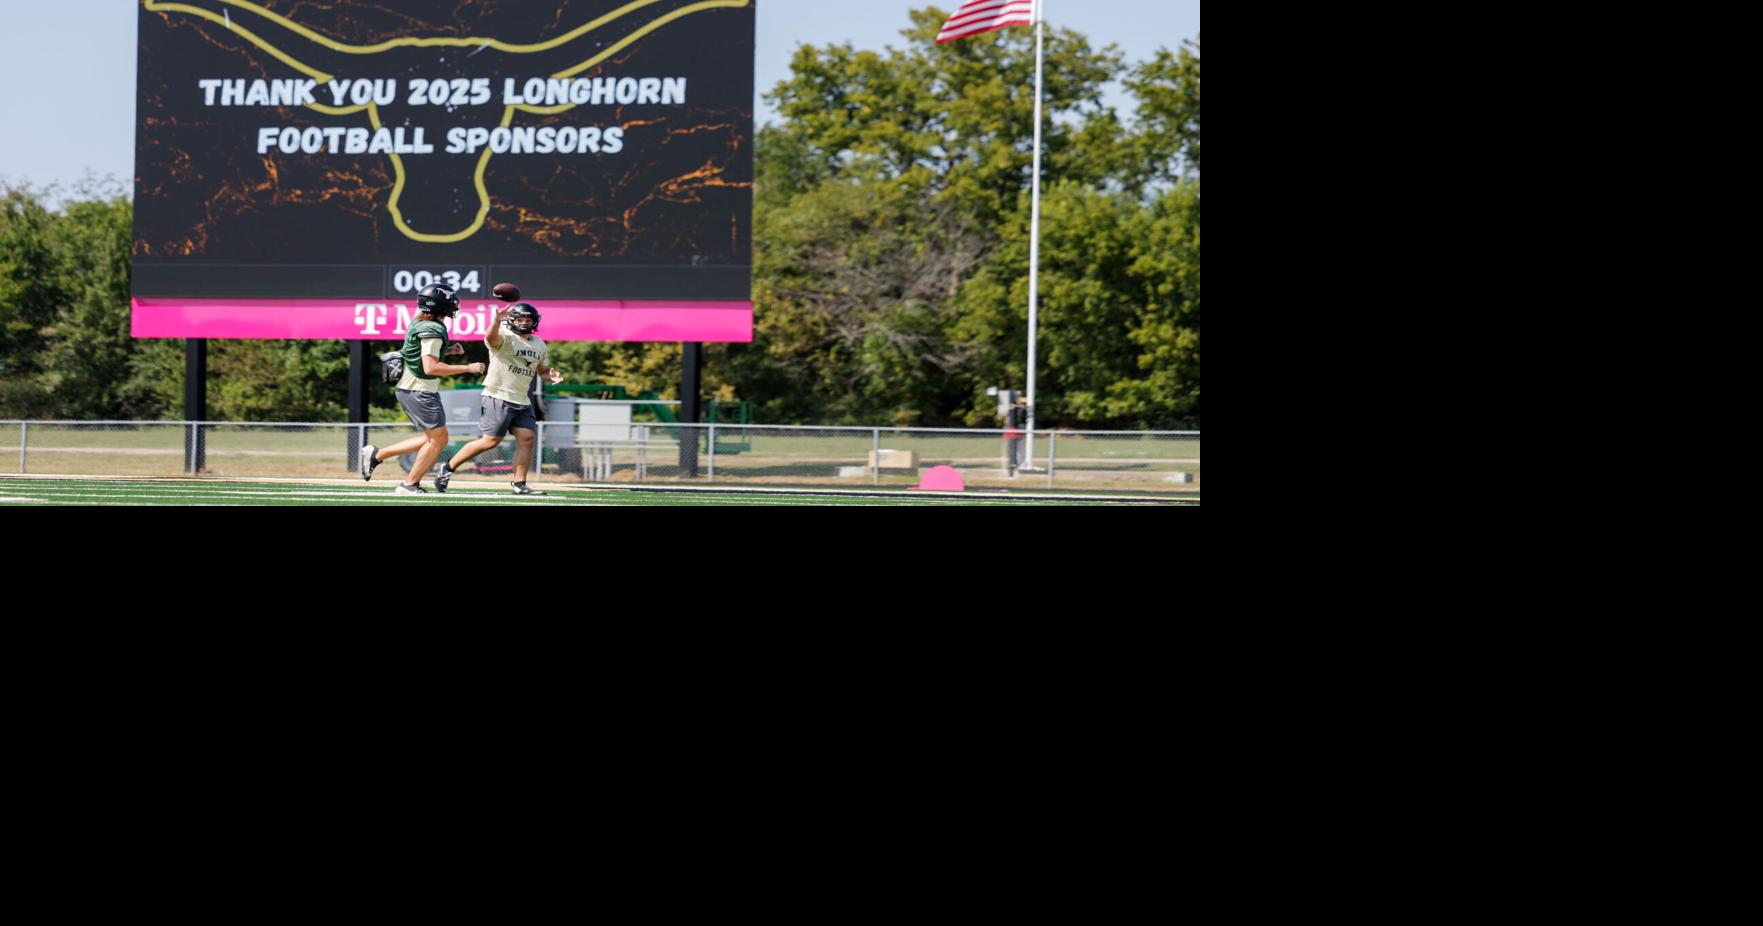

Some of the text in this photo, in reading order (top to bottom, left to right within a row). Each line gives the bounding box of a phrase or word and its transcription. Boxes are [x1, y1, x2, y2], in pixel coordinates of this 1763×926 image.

[199, 77, 686, 106] THANK YOU 2025 LONGHORN
[257, 127, 623, 154] FOOTBALL SPONSORS
[393, 270, 480, 293] 00:34
